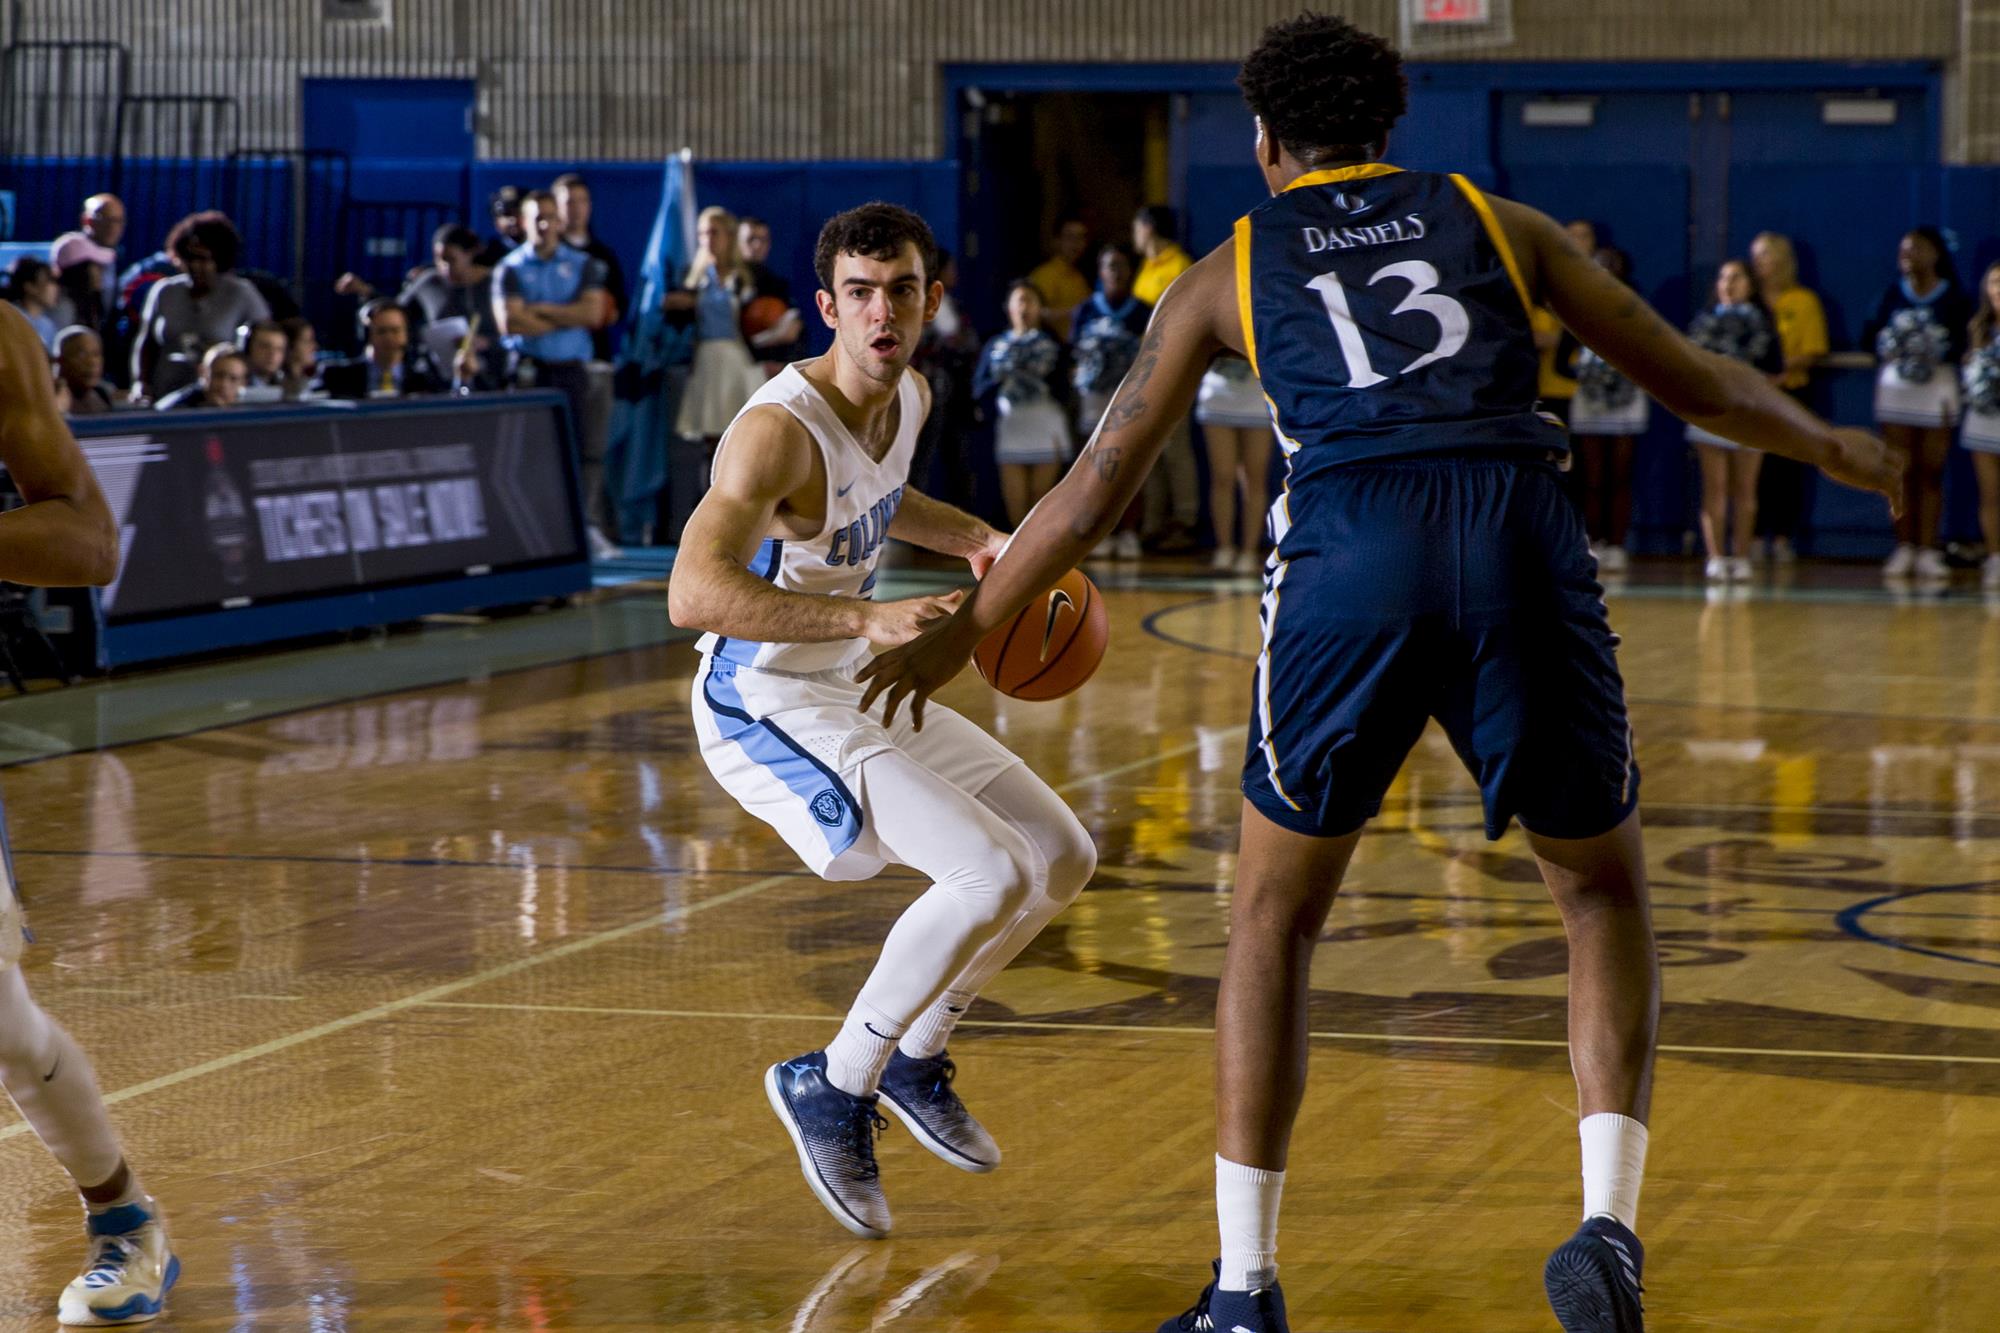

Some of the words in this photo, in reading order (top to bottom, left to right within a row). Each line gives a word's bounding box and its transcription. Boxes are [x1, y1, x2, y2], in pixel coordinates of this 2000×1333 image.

[1303, 213, 1425, 253] DANIELS
[1304, 259, 1470, 388] 13
[825, 482, 907, 567] COLUM
